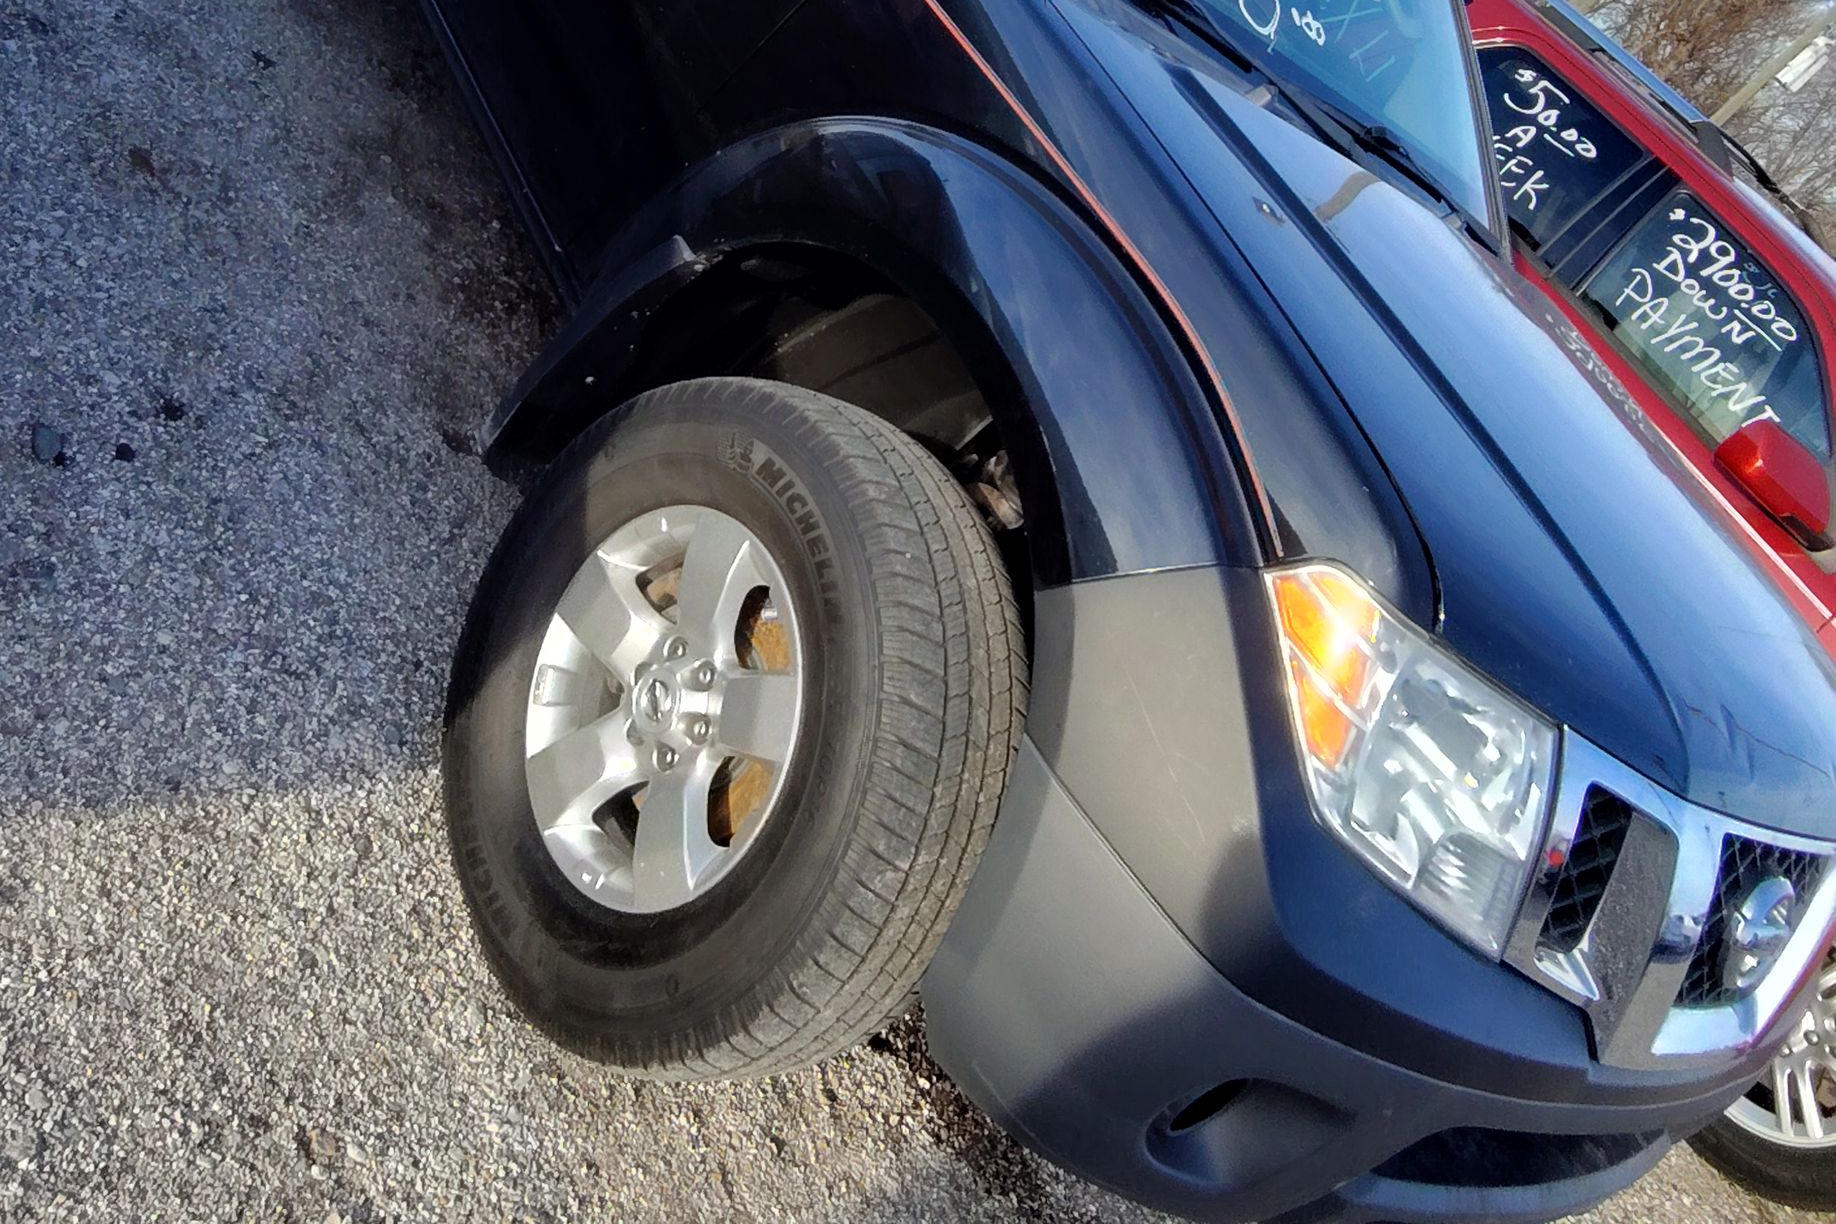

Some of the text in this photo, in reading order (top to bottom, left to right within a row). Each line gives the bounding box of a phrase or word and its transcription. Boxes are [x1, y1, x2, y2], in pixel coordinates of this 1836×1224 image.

[1503, 68, 1598, 159] $50.00
[1504, 125, 1537, 149] A
[1492, 136, 1550, 211] EK
[1652, 246, 1757, 345] DOWN
[1668, 207, 1798, 342] $2900.00
[1615, 267, 1782, 428] PAYMENT
[754, 456, 843, 624] MICHELIN
